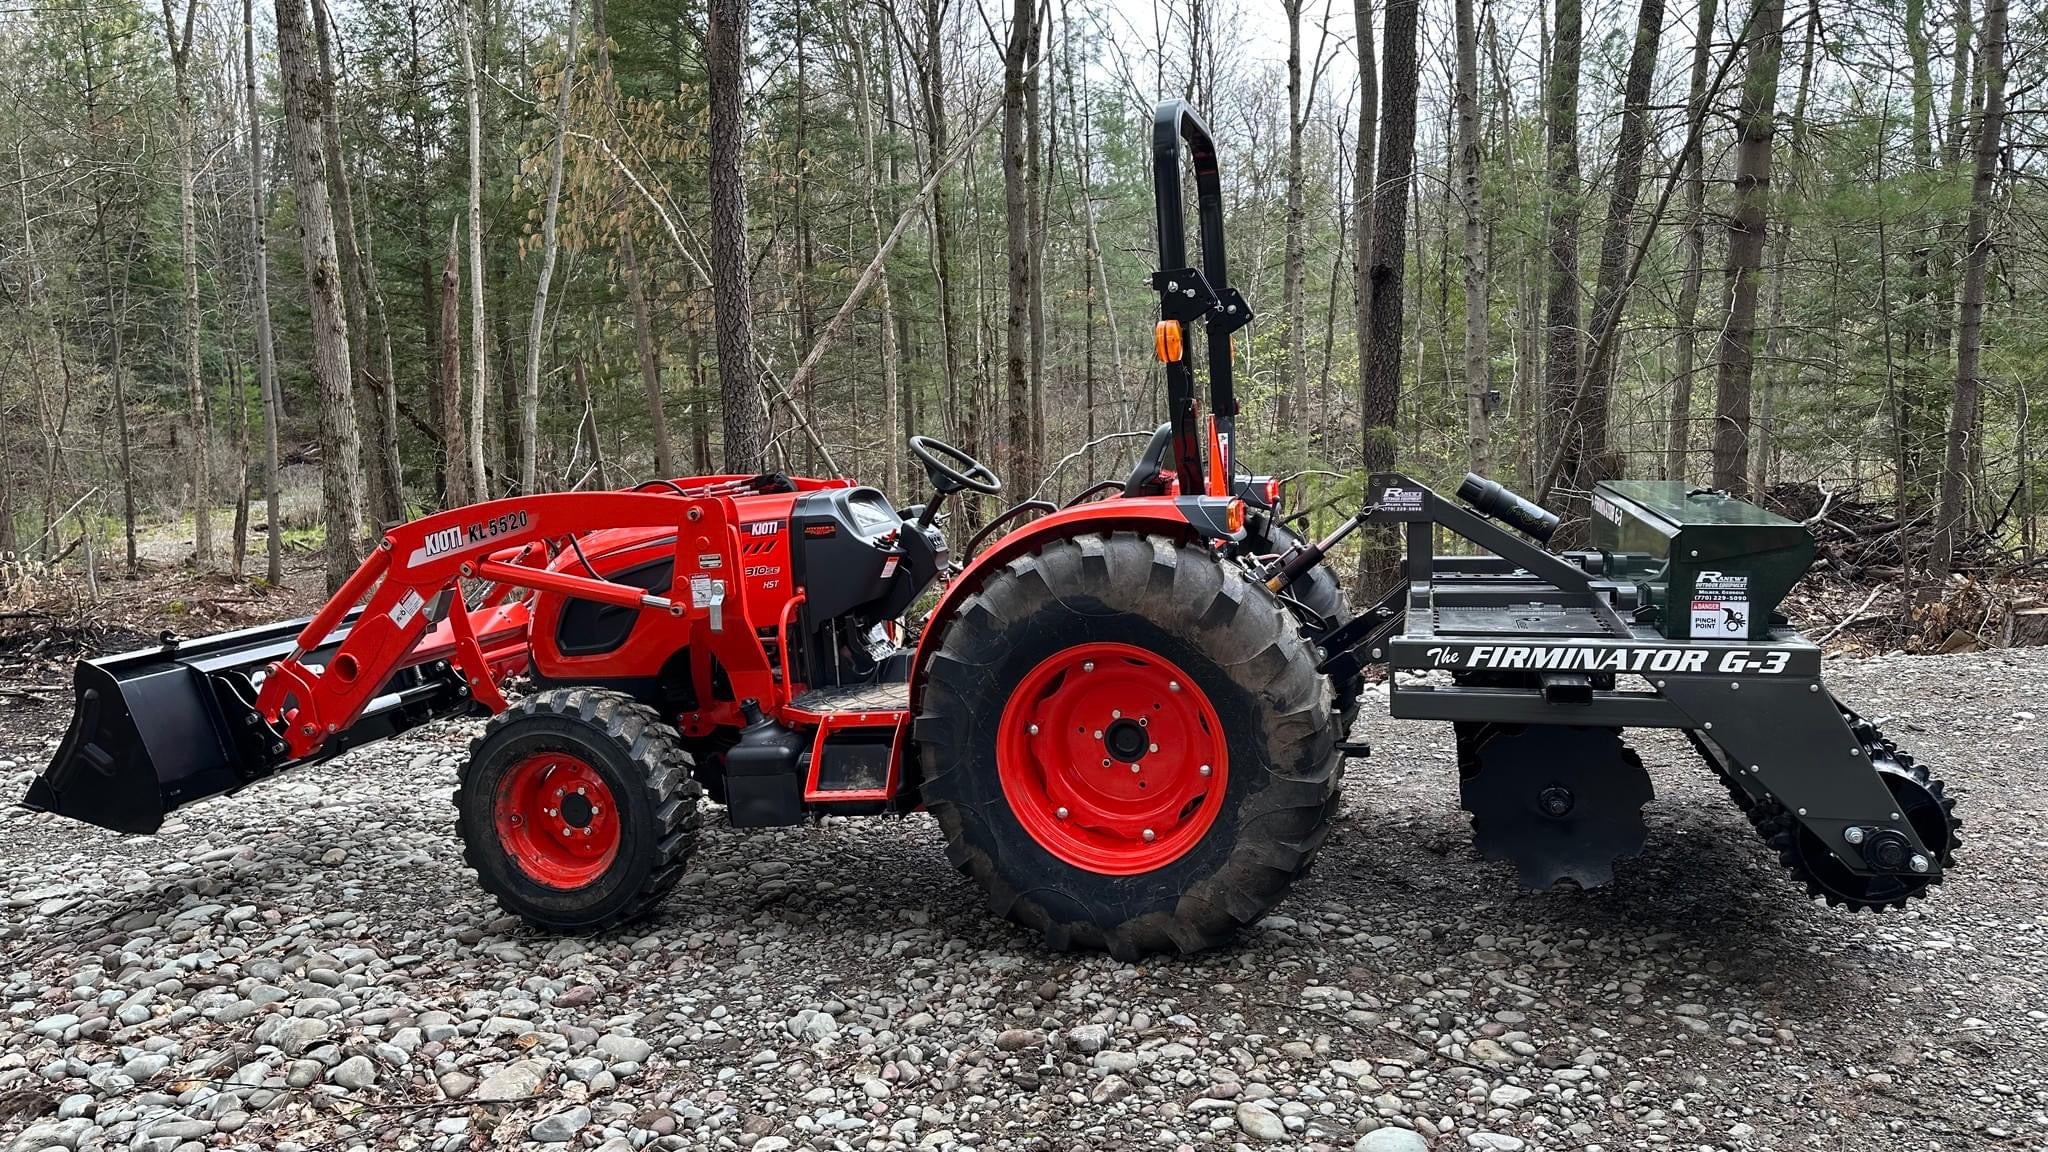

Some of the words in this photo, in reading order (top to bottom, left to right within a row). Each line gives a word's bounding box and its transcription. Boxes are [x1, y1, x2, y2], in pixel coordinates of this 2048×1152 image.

[424, 524, 463, 557] KIOTI
[751, 521, 778, 536] KIOTI
[1426, 646, 1460, 667] The
[1466, 646, 1709, 673] FIRMINATOR
[1718, 650, 1792, 674] G-3
